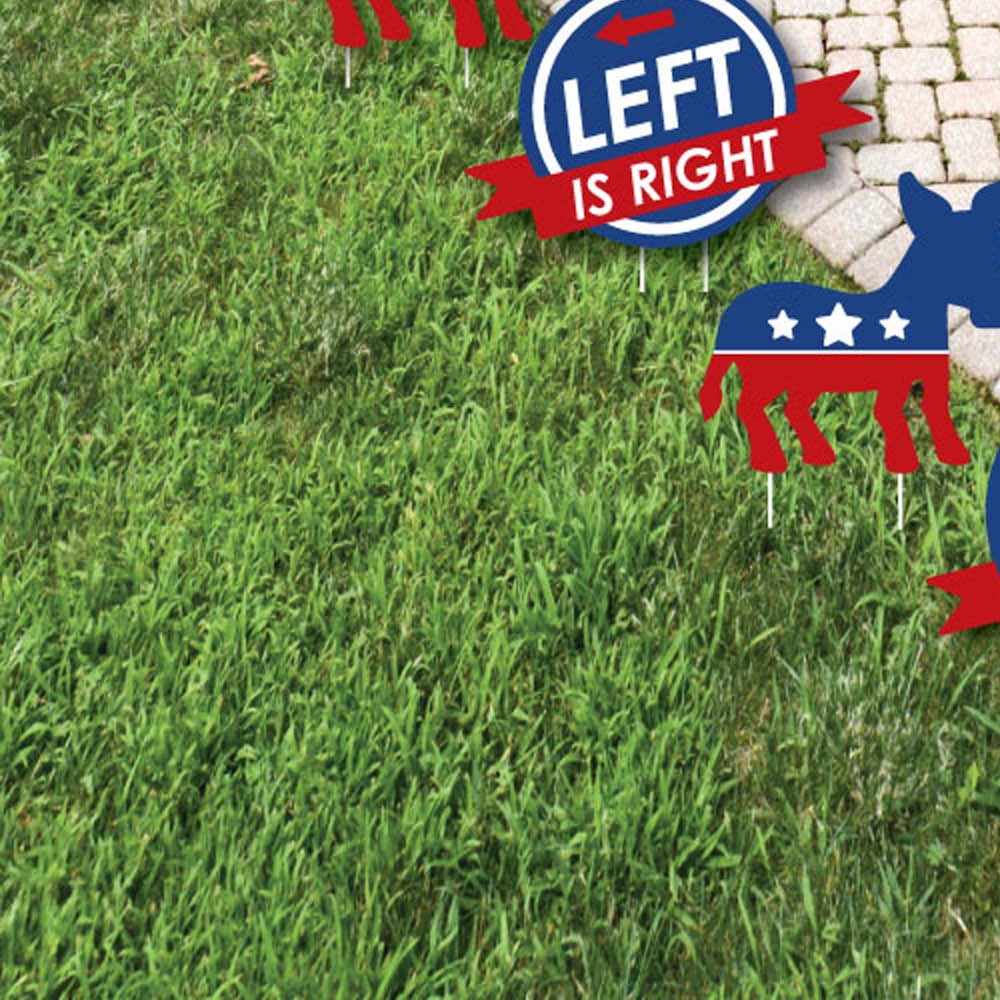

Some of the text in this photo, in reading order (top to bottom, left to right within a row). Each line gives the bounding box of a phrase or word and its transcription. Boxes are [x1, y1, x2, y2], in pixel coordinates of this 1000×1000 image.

[563, 37, 741, 155] LEFT
[572, 128, 779, 220] IS RIGHT
